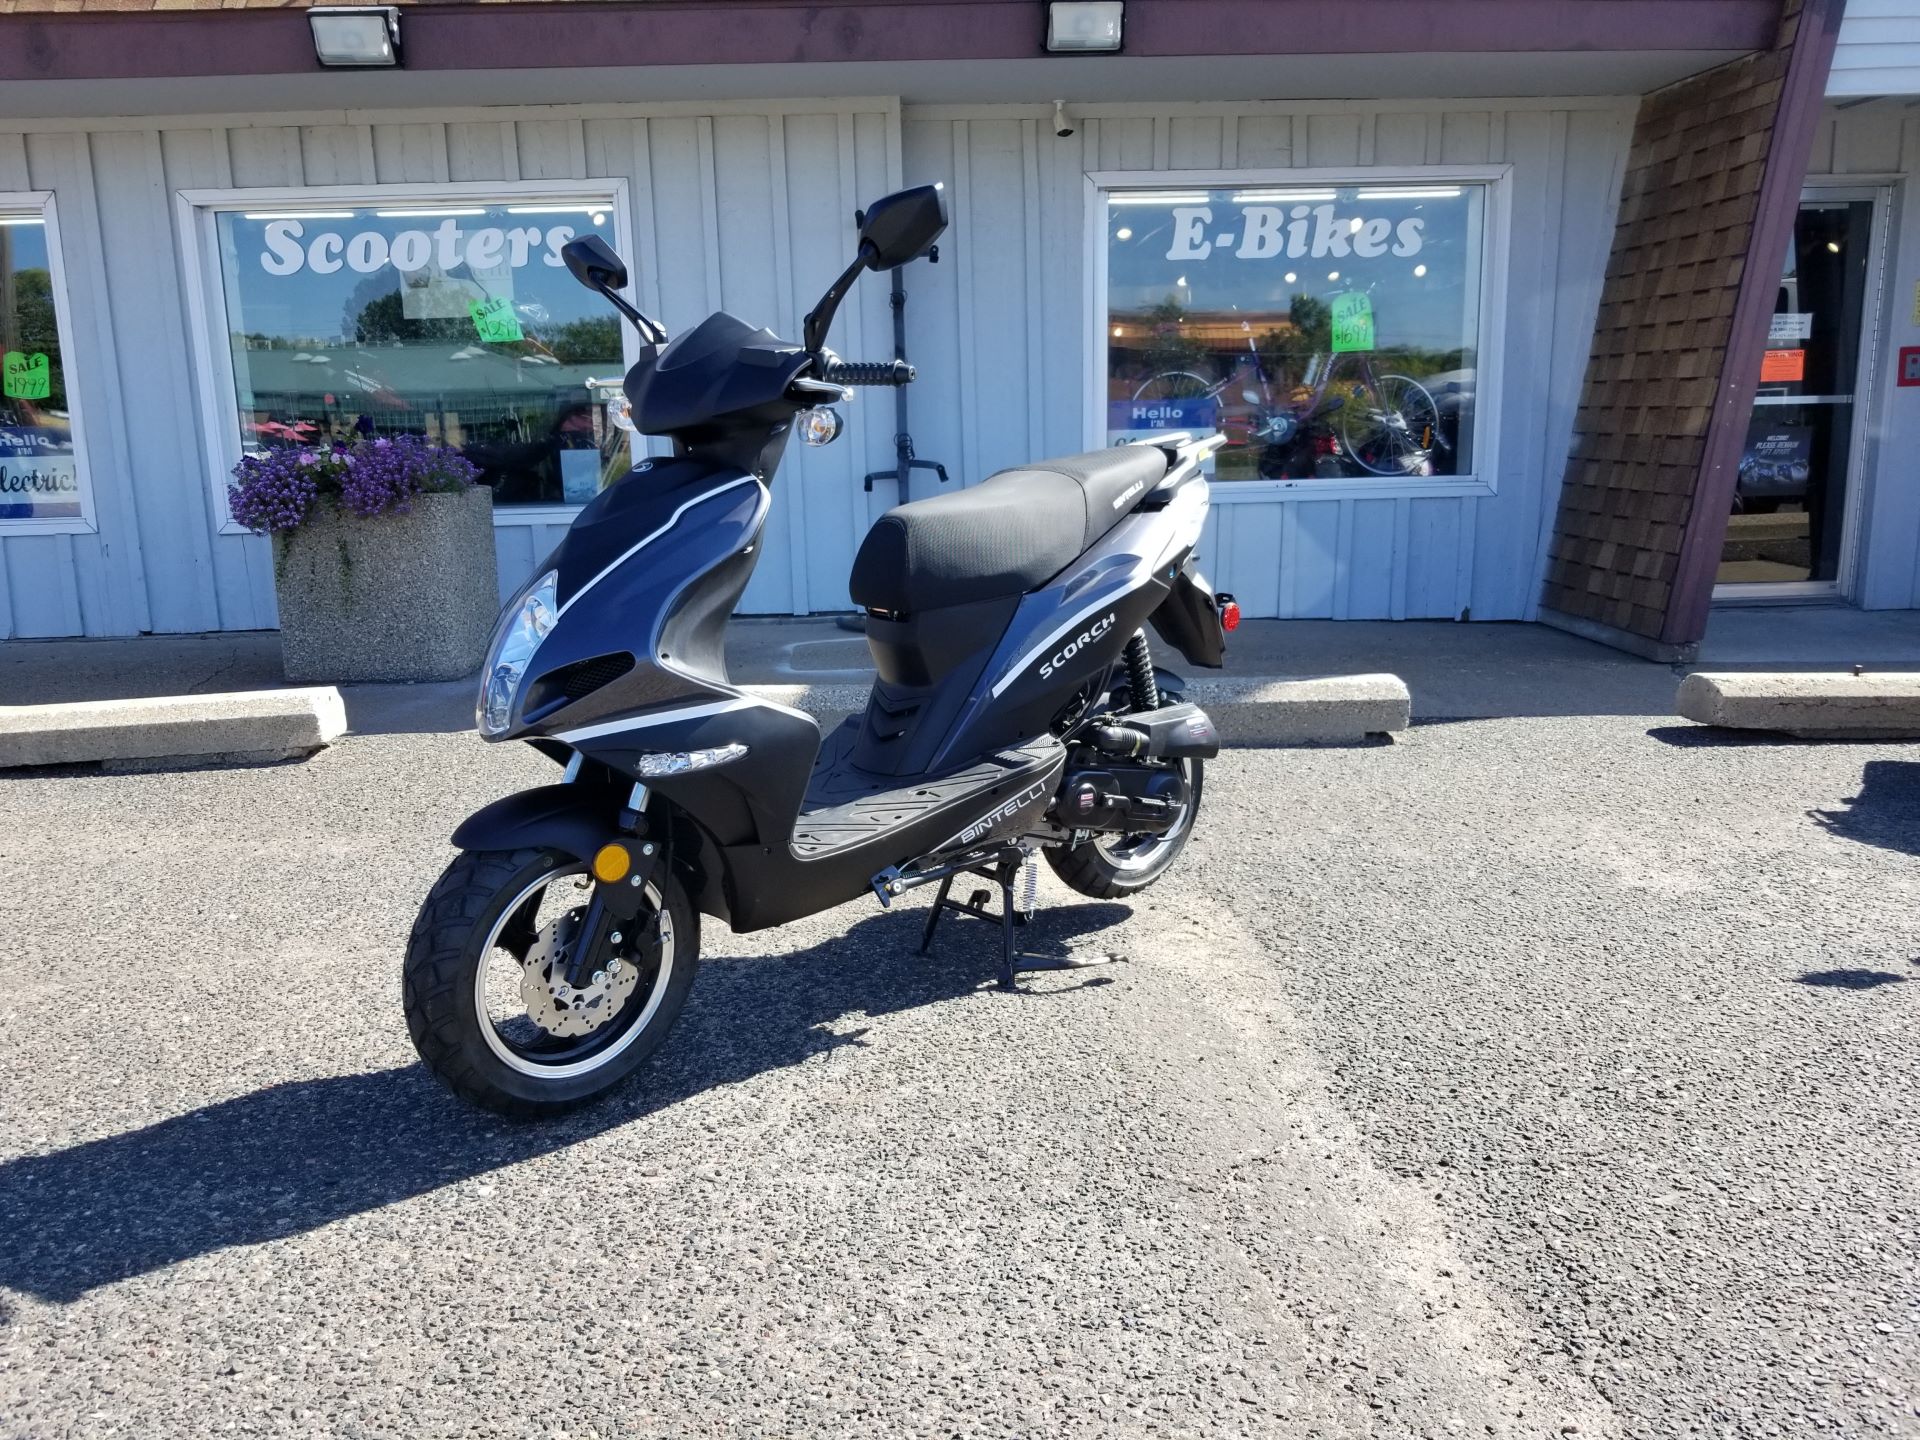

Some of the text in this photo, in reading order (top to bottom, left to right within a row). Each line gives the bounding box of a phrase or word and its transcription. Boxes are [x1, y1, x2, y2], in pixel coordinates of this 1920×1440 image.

[1166, 204, 1425, 261] E-Bikes
[261, 218, 575, 276] Scooters
[475, 299, 505, 320] SALE
[1337, 297, 1367, 324] SALE
[9, 357, 43, 375] SALE
[1132, 406, 1183, 419] Hello
[1150, 419, 1165, 428] I'M
[0, 432, 49, 447] Hello
[17, 447, 33, 455] I'M
[0, 464, 78, 493] lectric!
[1039, 612, 1116, 680] SCORCH
[961, 782, 1046, 844] BINTELLI
